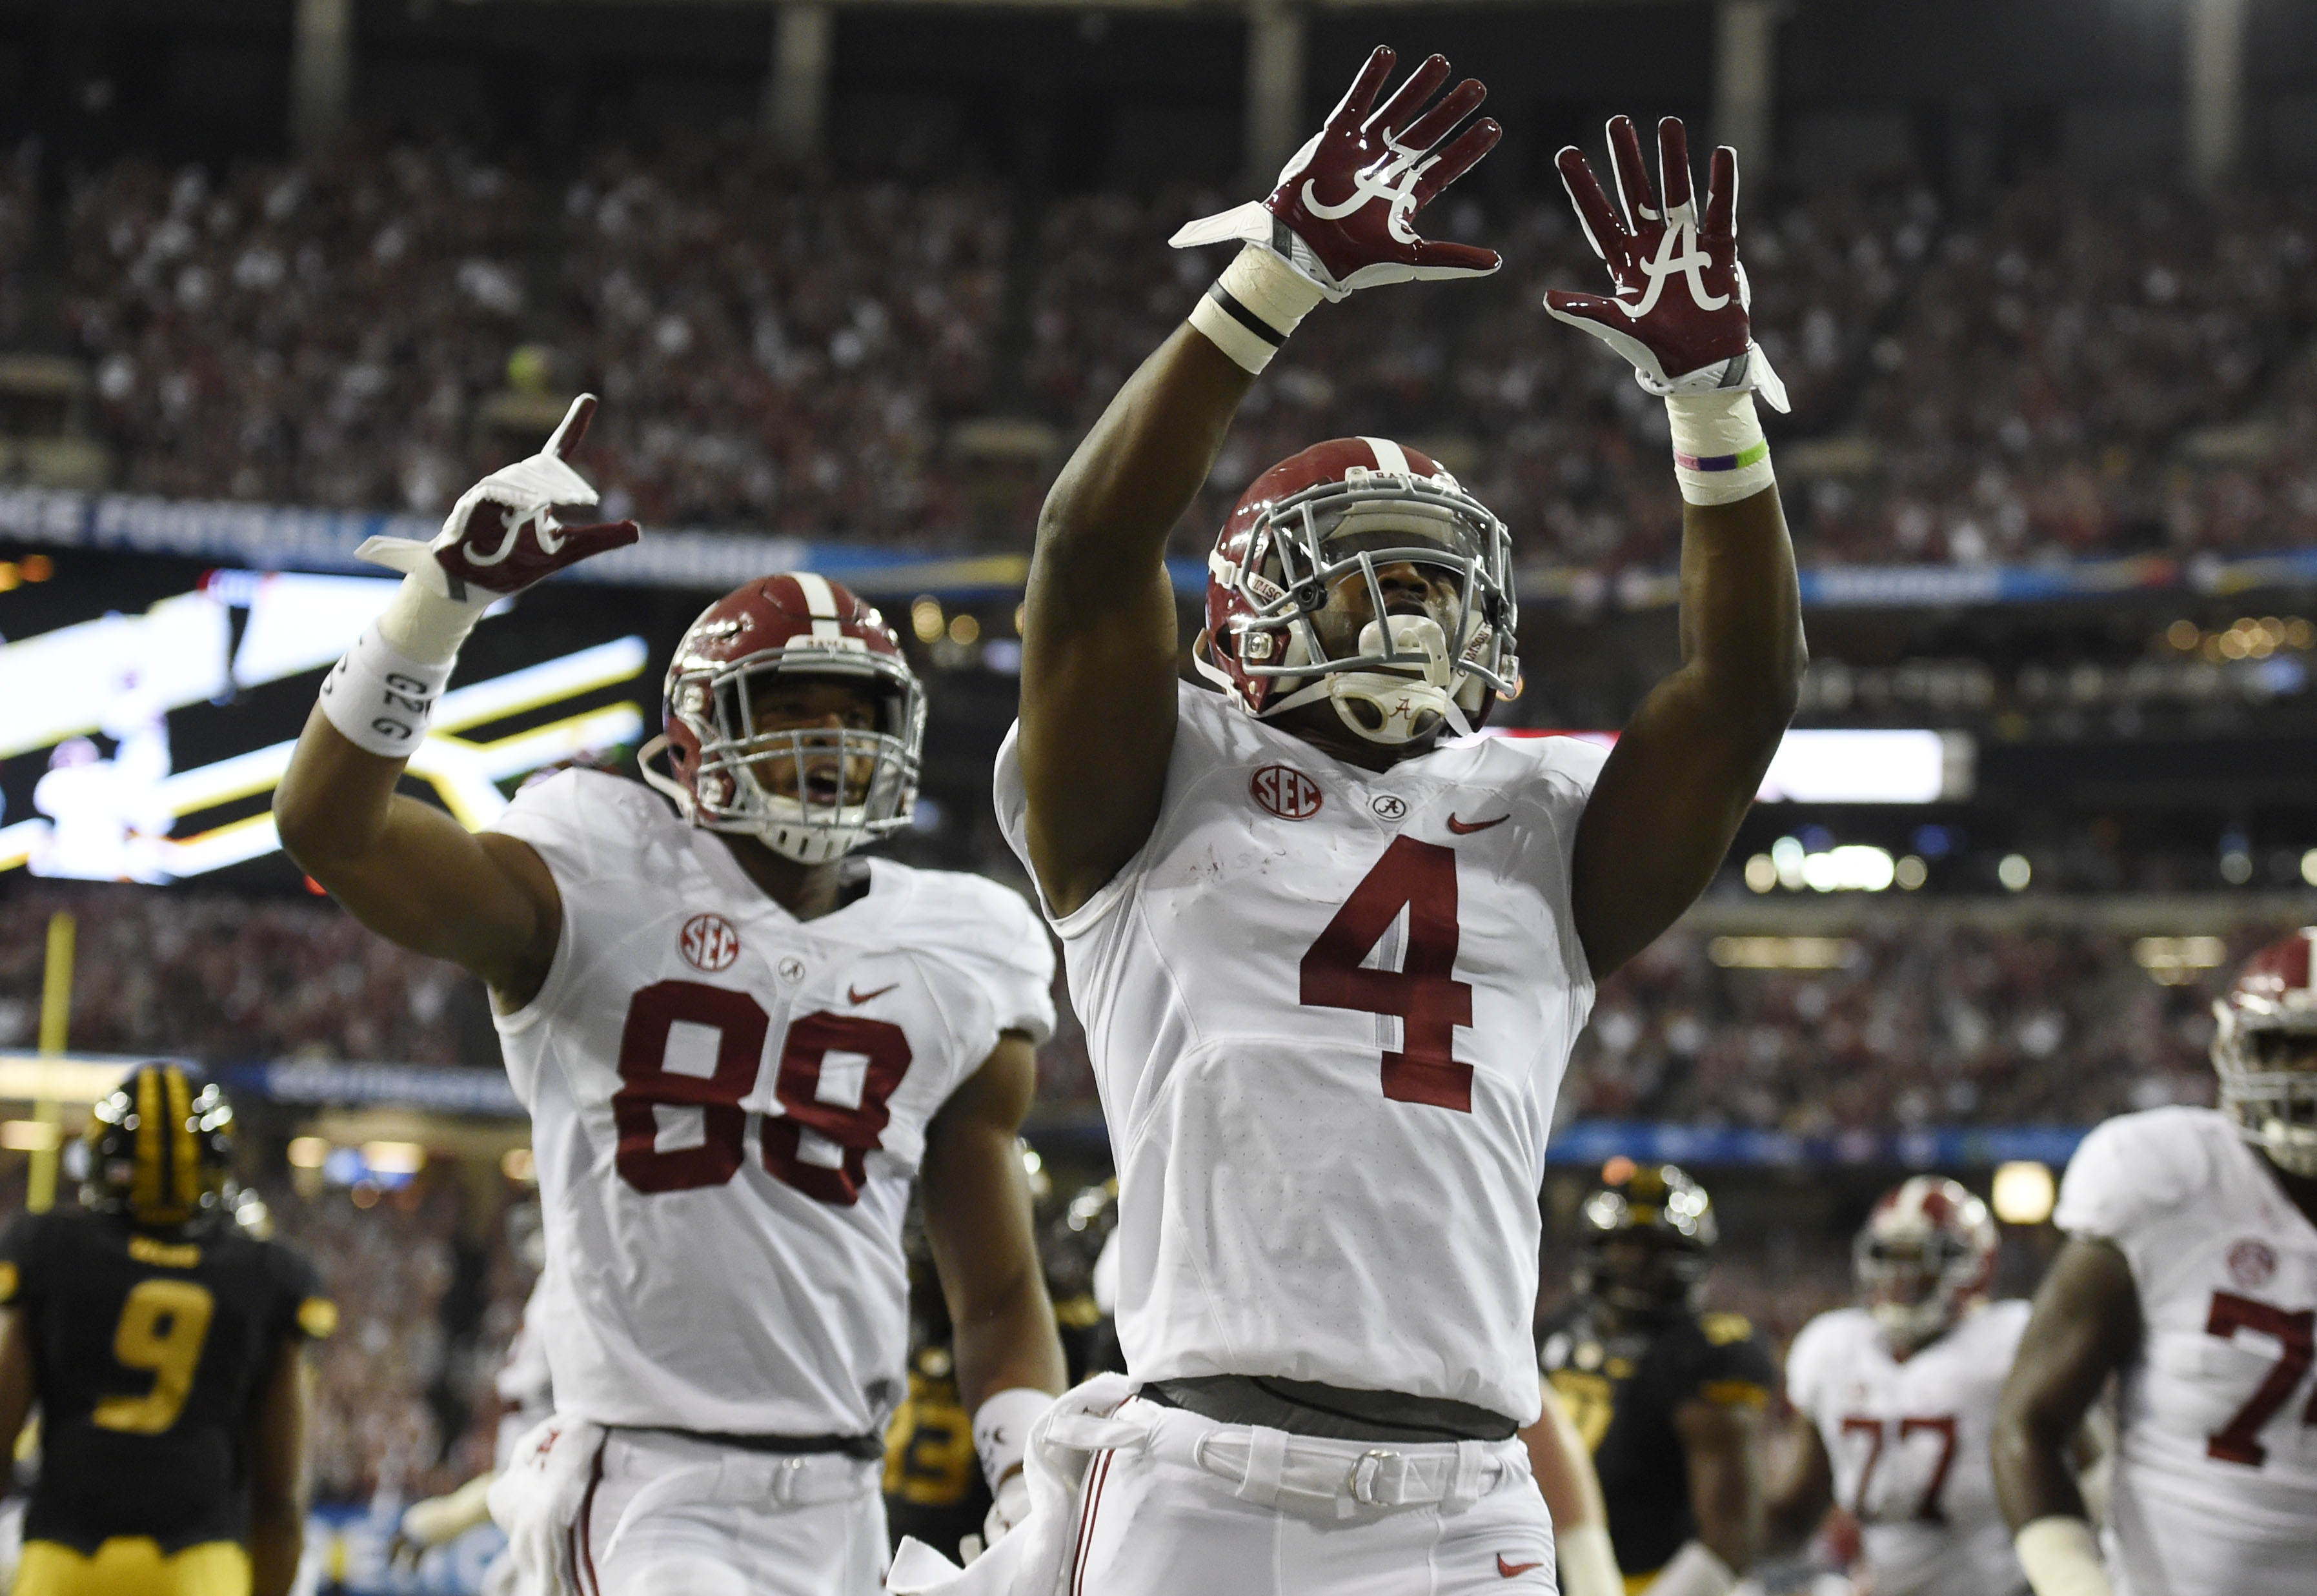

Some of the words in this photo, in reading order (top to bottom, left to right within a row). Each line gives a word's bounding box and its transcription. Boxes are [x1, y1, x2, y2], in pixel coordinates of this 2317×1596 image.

[1614, 196, 1730, 318] A
[1257, 768, 1317, 816] SEC
[683, 916, 735, 968] SEC
[1300, 834, 1473, 1113] 4
[612, 979, 912, 1206] 88
[93, 1278, 214, 1435] 9
[2207, 1291, 2317, 1466] 7
[1842, 1416, 1955, 1524] 77
